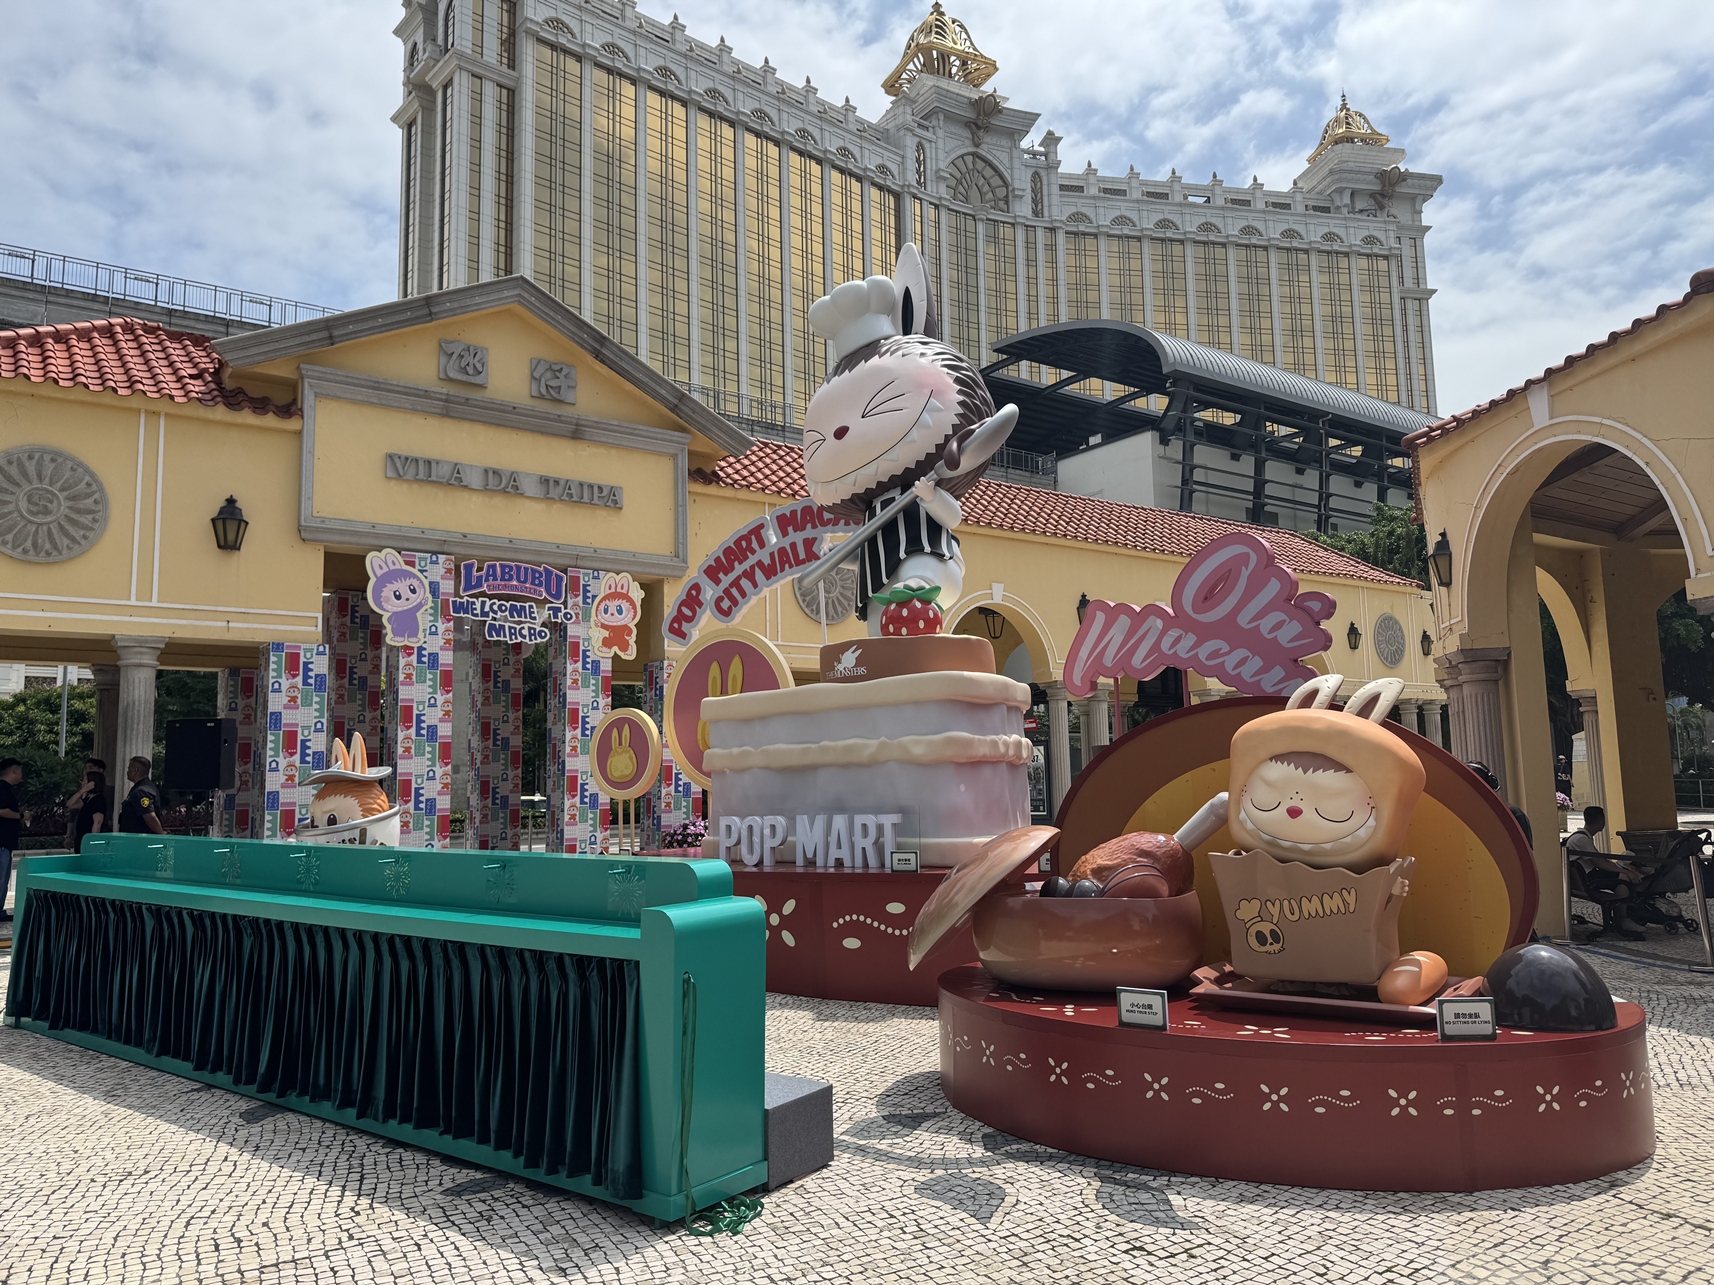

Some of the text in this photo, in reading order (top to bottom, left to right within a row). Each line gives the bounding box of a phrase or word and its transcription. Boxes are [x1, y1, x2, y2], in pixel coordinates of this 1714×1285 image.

[388, 453, 623, 508] VILA DA TAIPA
[462, 560, 566, 602] LABUBU
[504, 585, 543, 597] MONSTERS
[668, 504, 862, 640] POP MART MAC
[714, 536, 821, 618] CITYWALK
[451, 599, 574, 622] WELCOME TO
[486, 622, 548, 642] MACAO
[719, 813, 903, 867] POP MART
[1265, 887, 1357, 925] YUMMY
